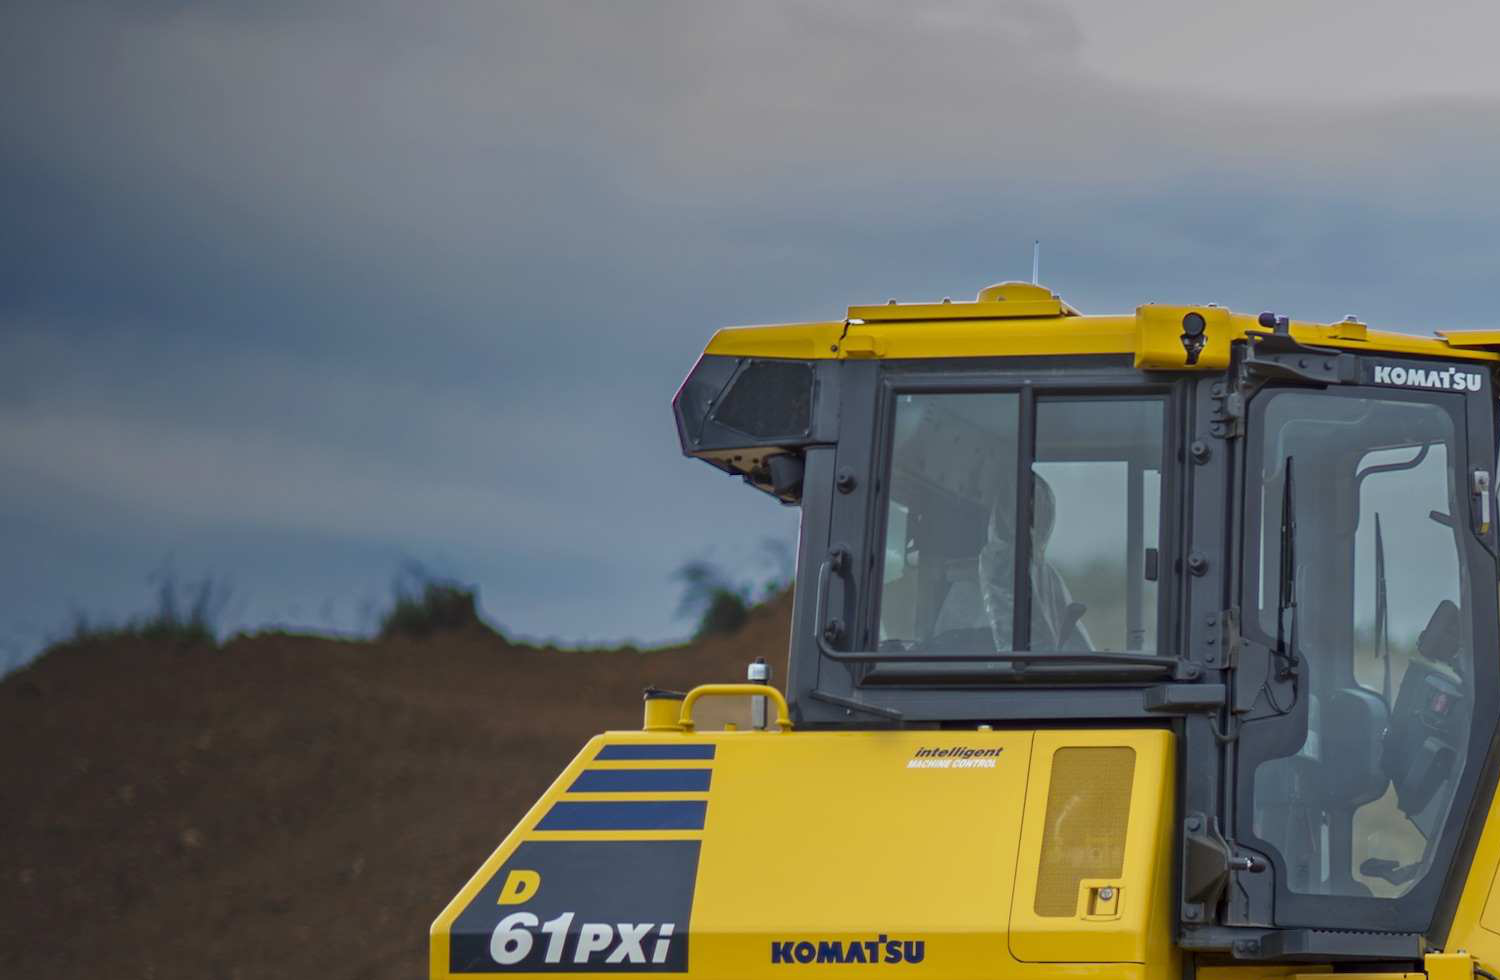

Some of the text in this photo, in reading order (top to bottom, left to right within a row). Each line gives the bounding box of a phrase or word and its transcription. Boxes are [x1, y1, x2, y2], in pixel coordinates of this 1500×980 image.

[1374, 366, 1481, 391] KOMATSU
[915, 747, 1003, 759] intelligent
[497, 870, 541, 905] D
[490, 912, 675, 965] 61PXi
[771, 934, 925, 964] KOMATSU
